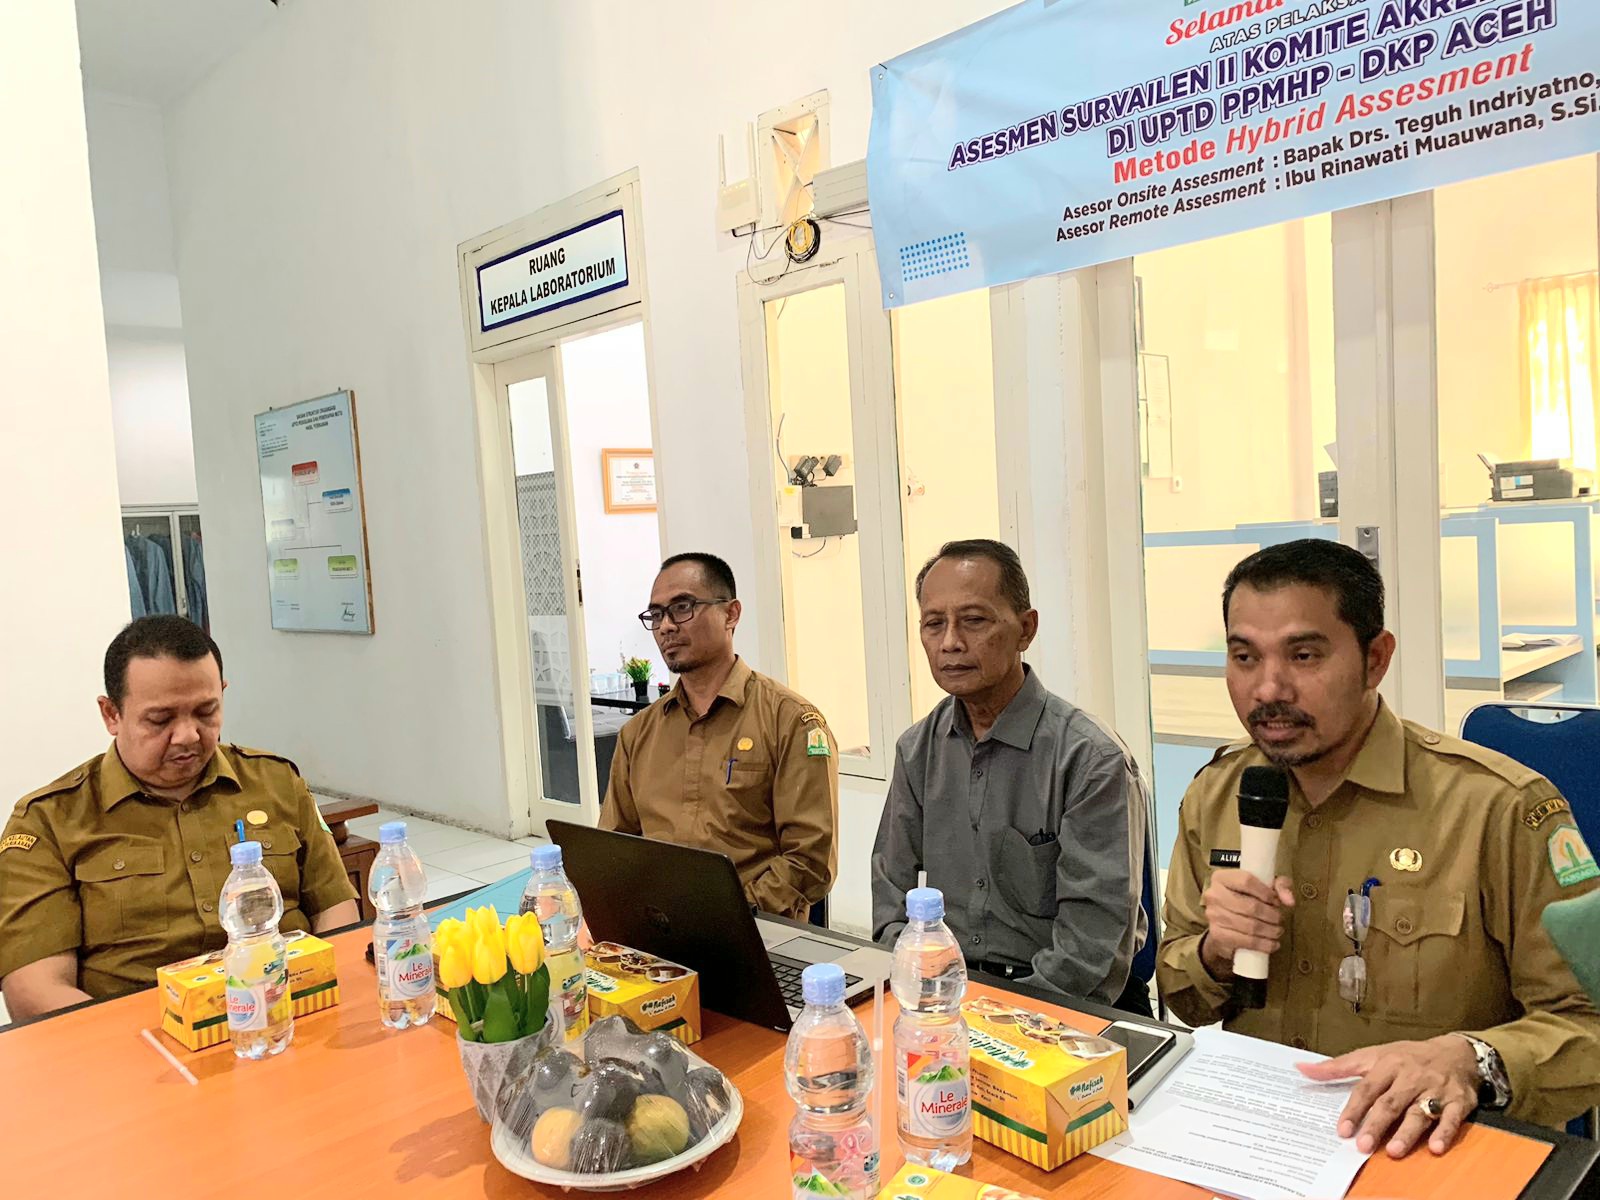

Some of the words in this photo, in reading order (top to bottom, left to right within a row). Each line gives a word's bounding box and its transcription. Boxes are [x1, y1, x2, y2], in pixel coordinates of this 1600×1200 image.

[1210, 23, 1261, 53] ATAS
[948, 112, 1058, 171] ASESMEN
[1061, 60, 1212, 136] SURVAILEN
[1215, 53, 1238, 90] II
[1243, 8, 1369, 79] KOMITE
[1373, 0, 1486, 40] AKR
[1107, 126, 1136, 157] DI
[1139, 99, 1218, 146] UPTD
[1220, 61, 1334, 123] PPMHP
[1336, 65, 1355, 81] -
[1359, 32, 1439, 83] DKP
[1441, 0, 1557, 59] ACEH
[1114, 139, 1216, 184] Metode
[1226, 102, 1326, 154] Hybrid
[1335, 43, 1534, 125] Assesment
[1063, 199, 1113, 221] Asesor
[1117, 185, 1167, 208] Onsite
[1172, 156, 1264, 195] Assesment
[1284, 136, 1344, 167] Bapak
[1350, 128, 1390, 149] Drs.
[1395, 105, 1462, 136] Teguh
[1469, 72, 1600, 118] Indriyatno,
[1056, 219, 1106, 241] Asesor
[1109, 203, 1169, 229] Remote
[1173, 176, 1267, 215] Assesment
[1286, 168, 1316, 188] Ibu
[1321, 143, 1409, 178] Rinawati
[1416, 114, 1544, 156] Muauwana,
[490, 290, 528, 315] KEPALA
[530, 257, 616, 302] LABORATORIUM
[529, 247, 566, 275] RUANG
[412, 962, 423, 972] Le
[229, 994, 239, 1004] Le
[940, 1091, 954, 1102] Le
